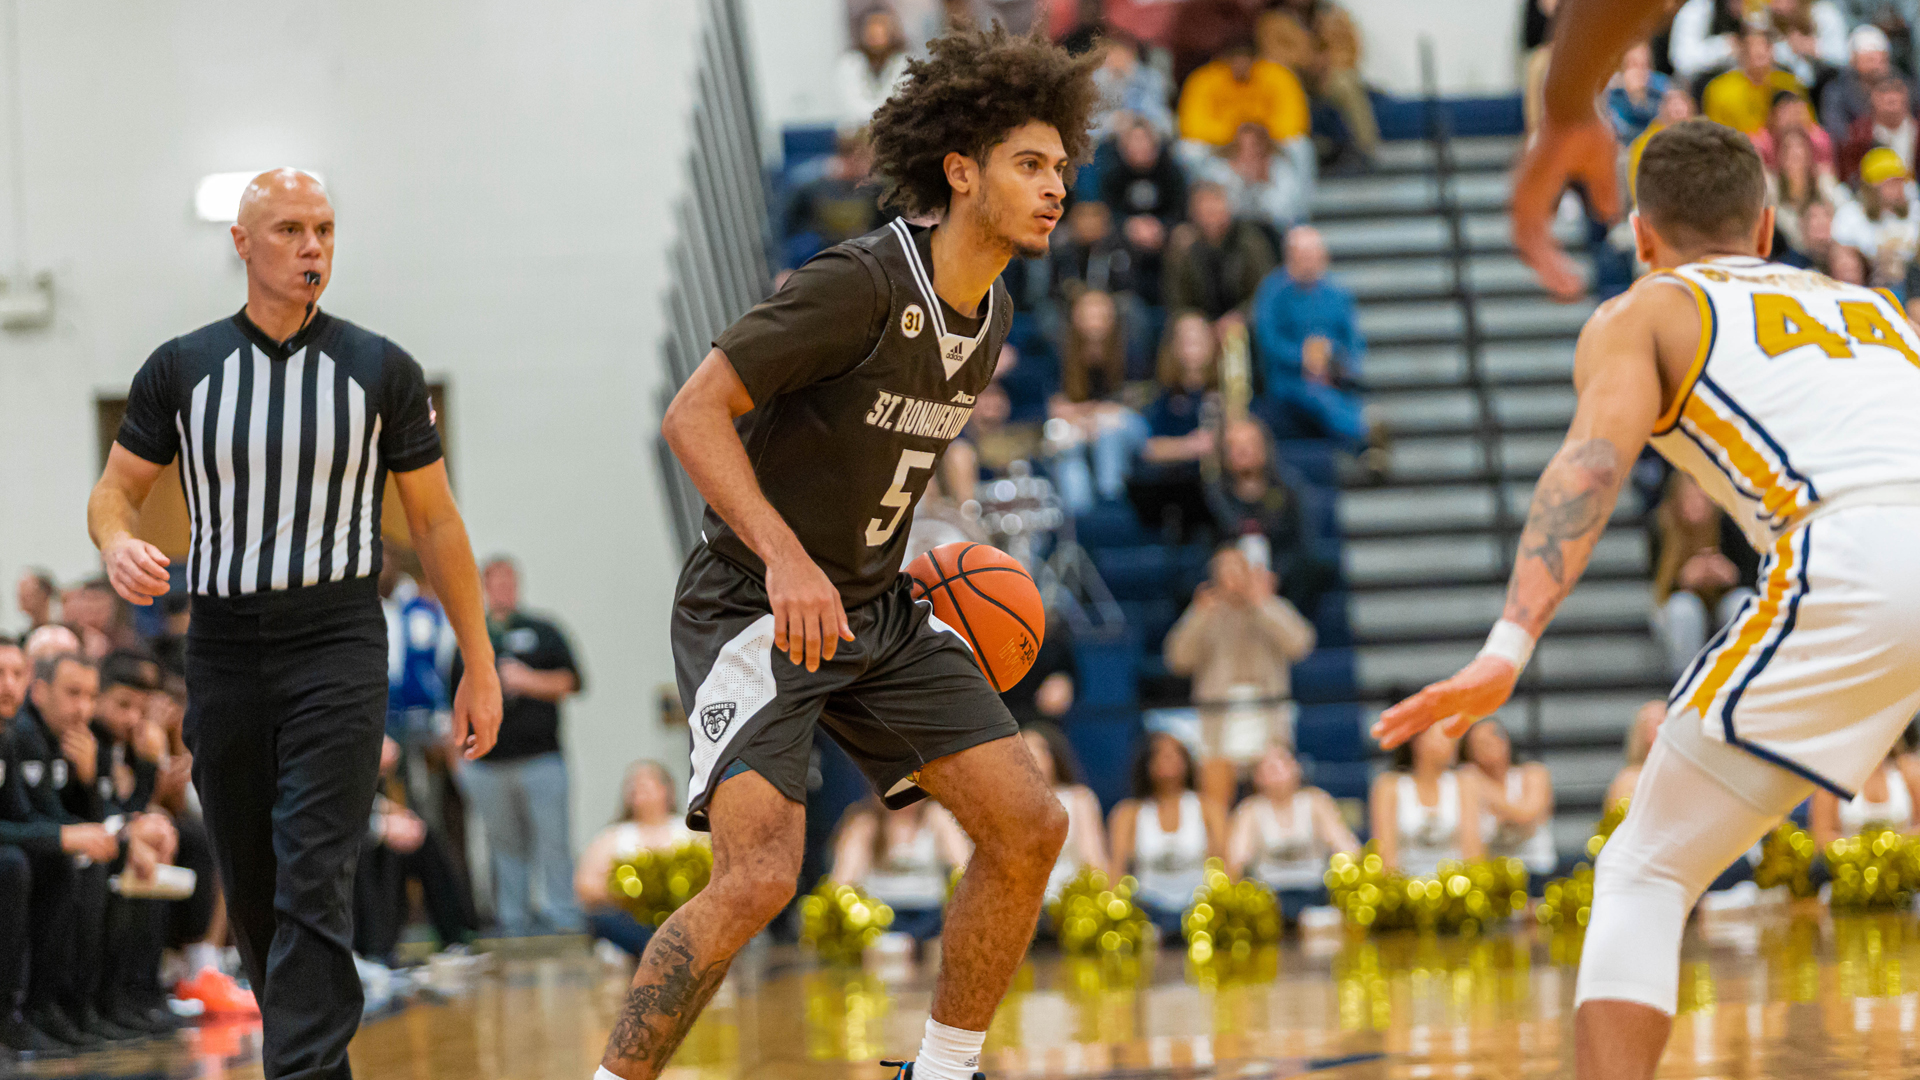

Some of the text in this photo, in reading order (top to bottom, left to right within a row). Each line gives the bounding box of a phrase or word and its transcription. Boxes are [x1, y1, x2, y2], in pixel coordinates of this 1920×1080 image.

[904, 311, 921, 332] 31
[1750, 291, 1920, 370] 44
[945, 352, 964, 362] adidas
[866, 390, 975, 440] ST. BONAVENTU
[865, 448, 936, 547] 5
